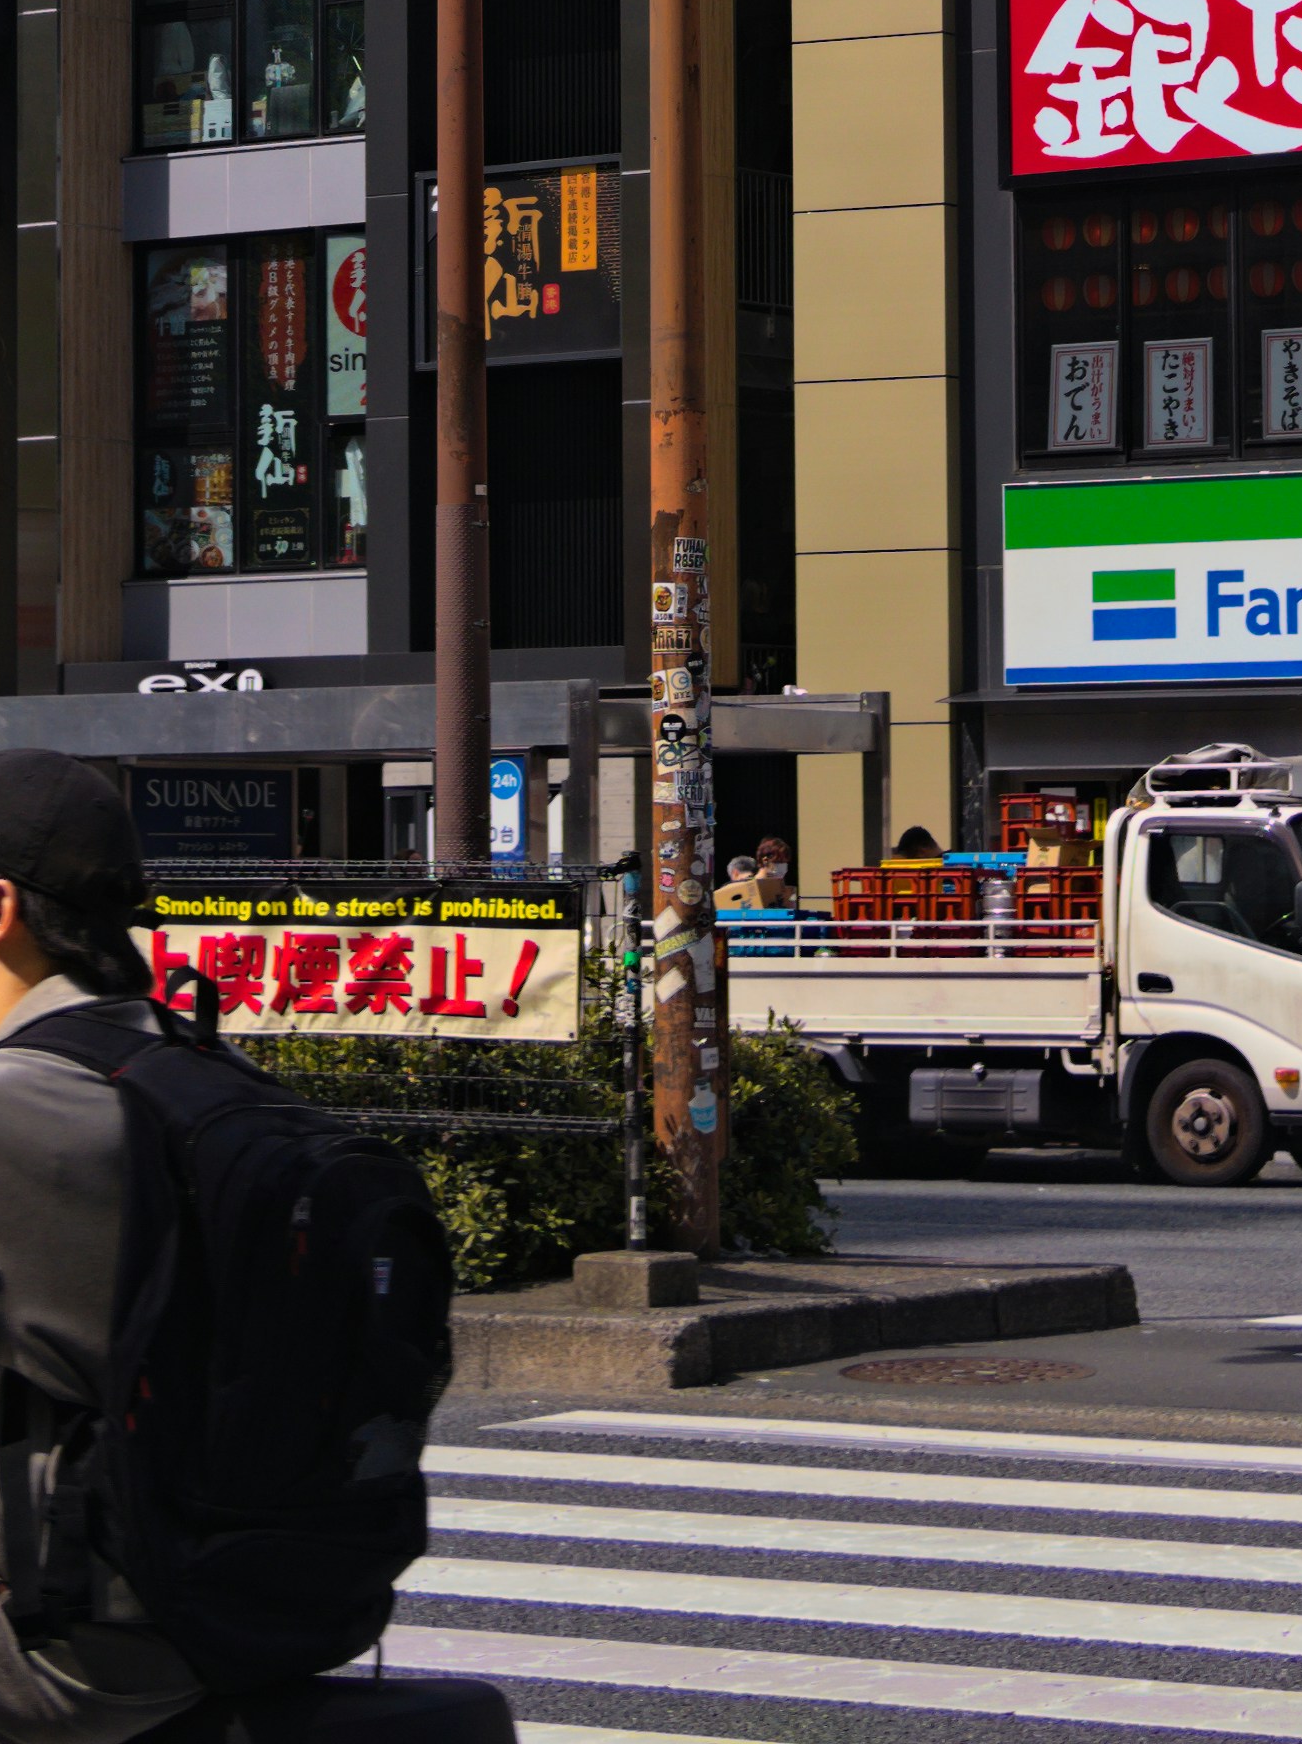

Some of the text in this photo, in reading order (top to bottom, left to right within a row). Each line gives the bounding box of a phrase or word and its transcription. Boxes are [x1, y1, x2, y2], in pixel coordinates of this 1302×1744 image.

[1063, 355, 1091, 442] おでん
[1161, 350, 1180, 441] たこやき
[1280, 338, 1302, 432] やきそば
[145, 778, 278, 812] SUBNADE
[491, 772, 519, 790] 24h
[155, 895, 564, 922] Smoking on the street is prohibited.
